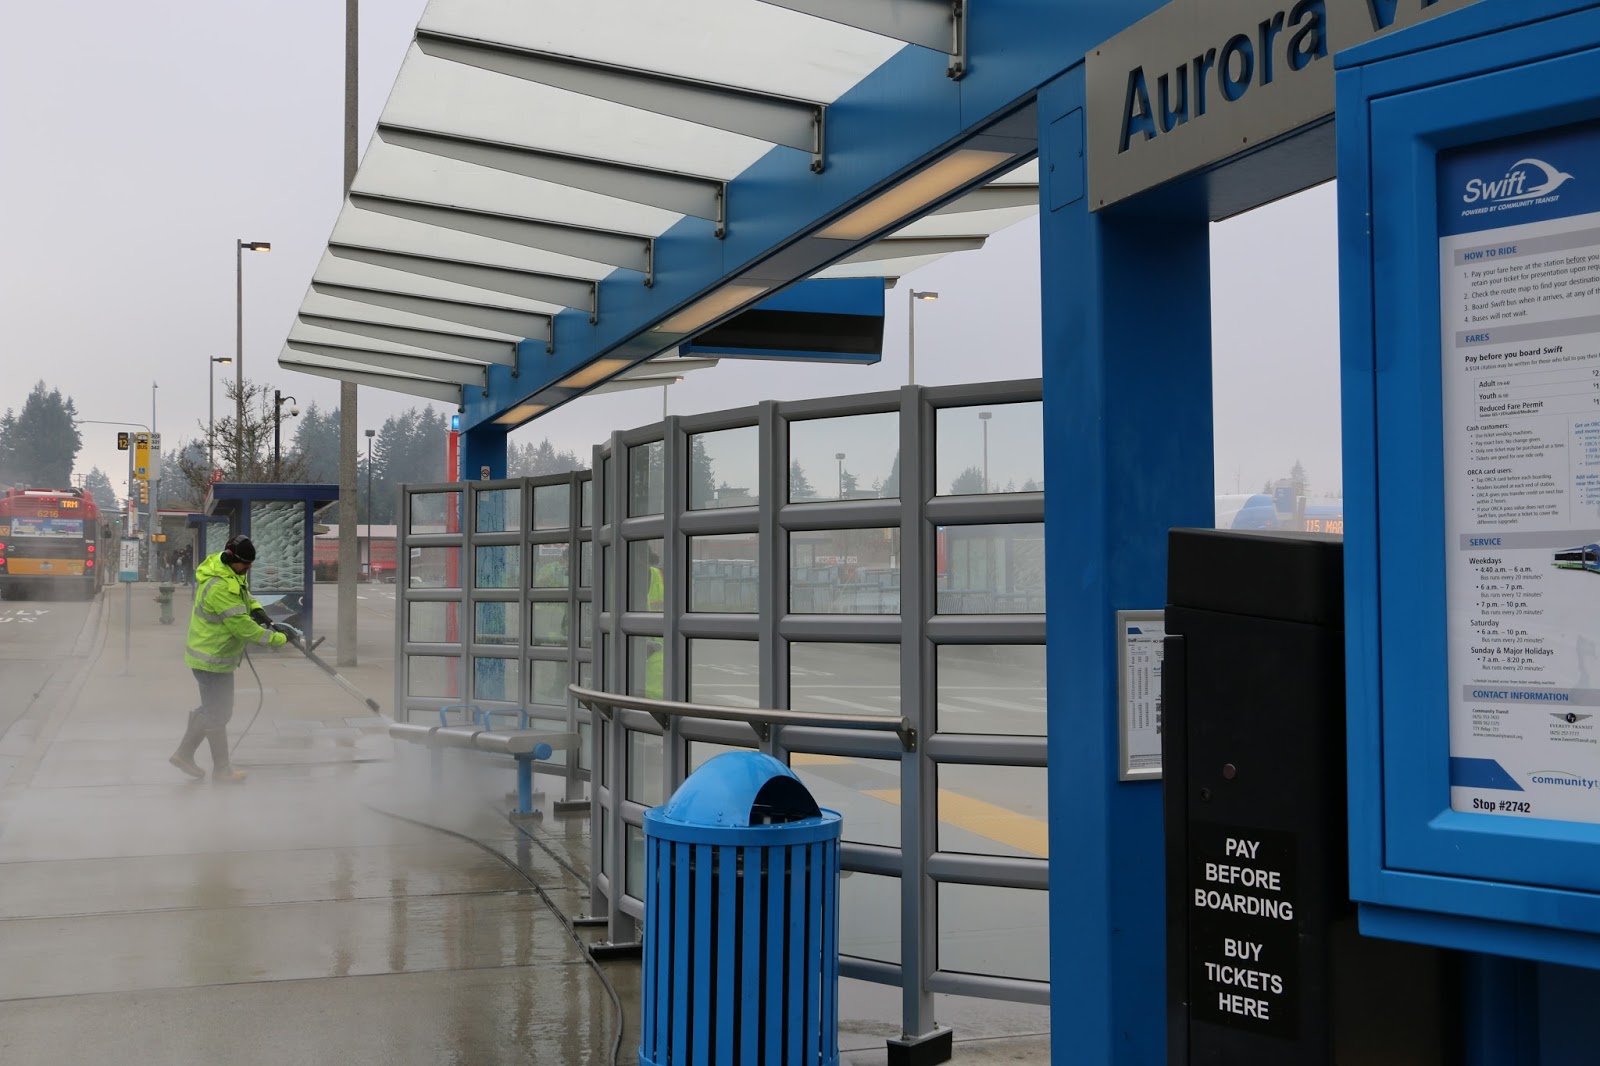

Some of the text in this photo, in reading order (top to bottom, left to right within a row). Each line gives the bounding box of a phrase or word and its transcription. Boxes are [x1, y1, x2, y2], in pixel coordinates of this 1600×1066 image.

[1118, 0, 1328, 154] Aurora
[1463, 170, 1526, 203] Swift
[1462, 207, 1488, 216] POWERED
[1498, 200, 1533, 211] COMMUNITY
[1535, 195, 1559, 204] TRANSIT
[1464, 251, 1483, 260] HOW
[1499, 246, 1516, 255] RIDE
[1544, 259, 1564, 267] station
[1566, 256, 1586, 264] before
[1531, 268, 1568, 279] presentation
[1570, 266, 1586, 274] upon
[1472, 302, 1488, 310] Board
[1466, 334, 1489, 342] FARES
[1480, 353, 1502, 361] before
[1520, 348, 1540, 356] board
[1543, 345, 1562, 354] Swift
[1306, 520, 1319, 532] 115
[1511, 692, 1568, 701] INFORMATION
[1473, 798, 1530, 813] Stop #2742
[1225, 838, 1260, 859] PAY
[1205, 863, 1280, 891] BEFORE
[1195, 888, 1293, 920] BOARDING
[1225, 938, 1262, 961] BUY
[1205, 962, 1283, 994] TICKETS
[1219, 992, 1269, 1020] HERE
